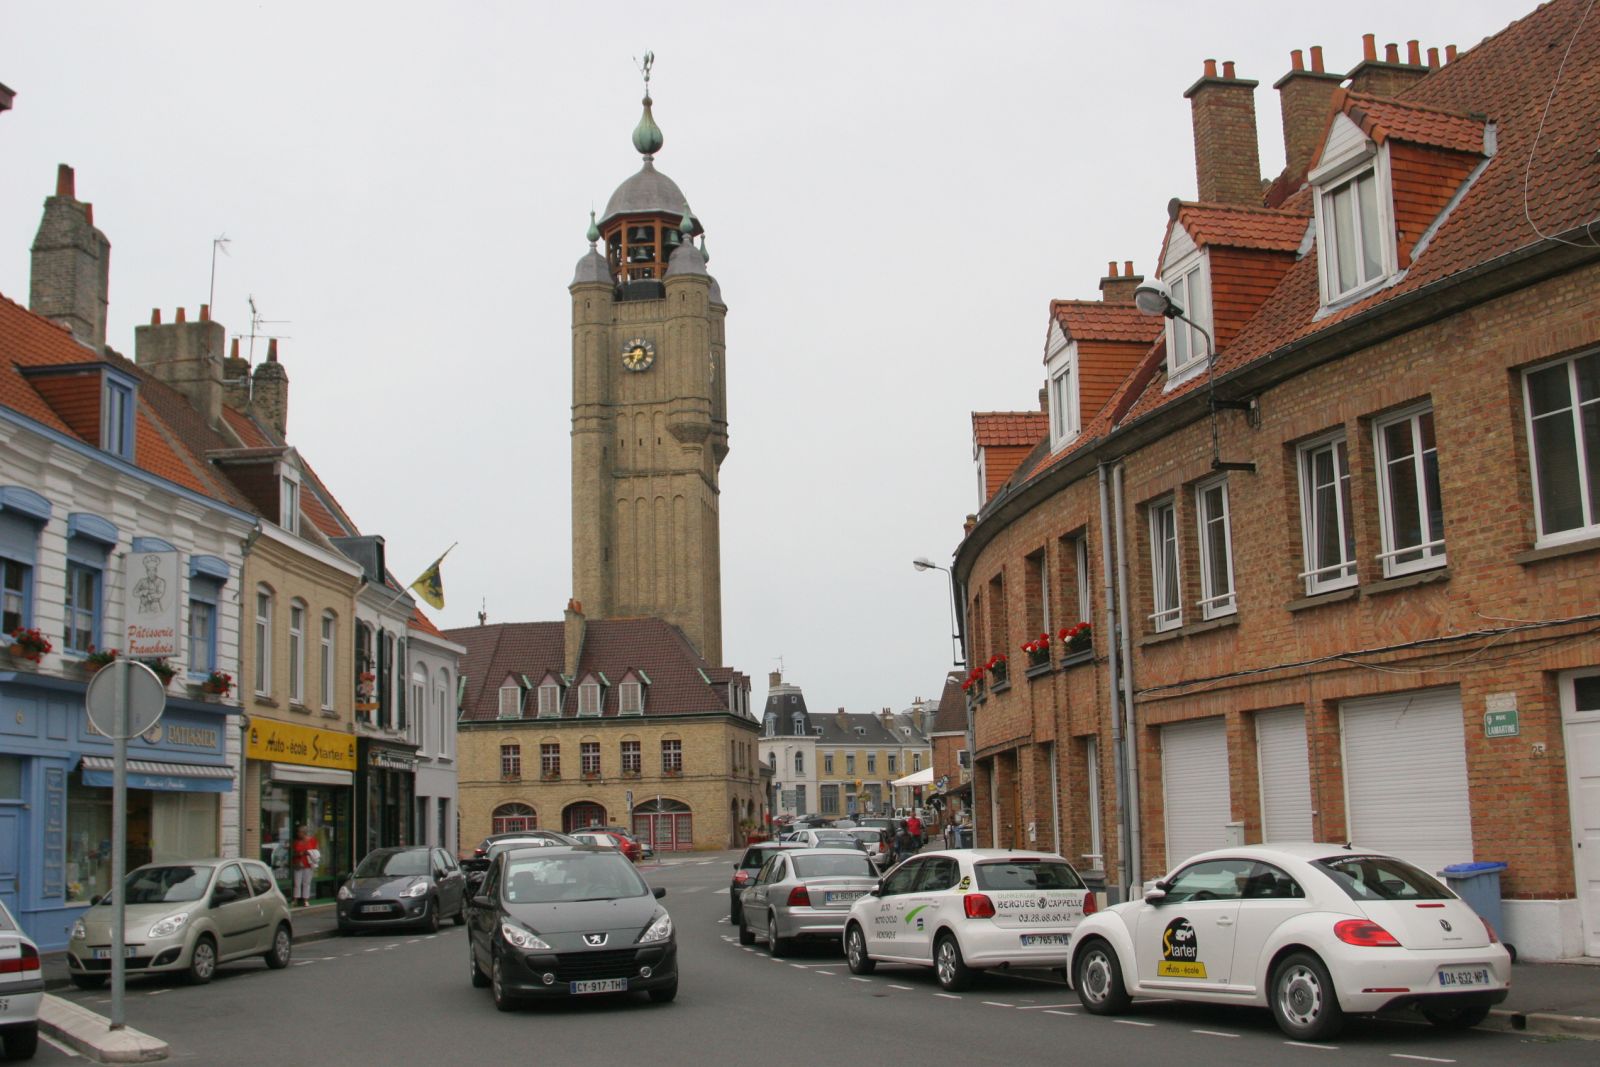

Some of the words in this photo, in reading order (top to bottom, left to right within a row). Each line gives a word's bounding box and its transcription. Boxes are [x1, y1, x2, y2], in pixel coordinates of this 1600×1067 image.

[1488, 725, 1516, 735] LAMARTINE
[313, 734, 344, 760] Starter
[1532, 745, 1544, 758] 25
[997, 899, 1036, 909] BERGUES
[1047, 899, 1082, 908] CAPPELLE
[1164, 928, 1196, 957] Starter
